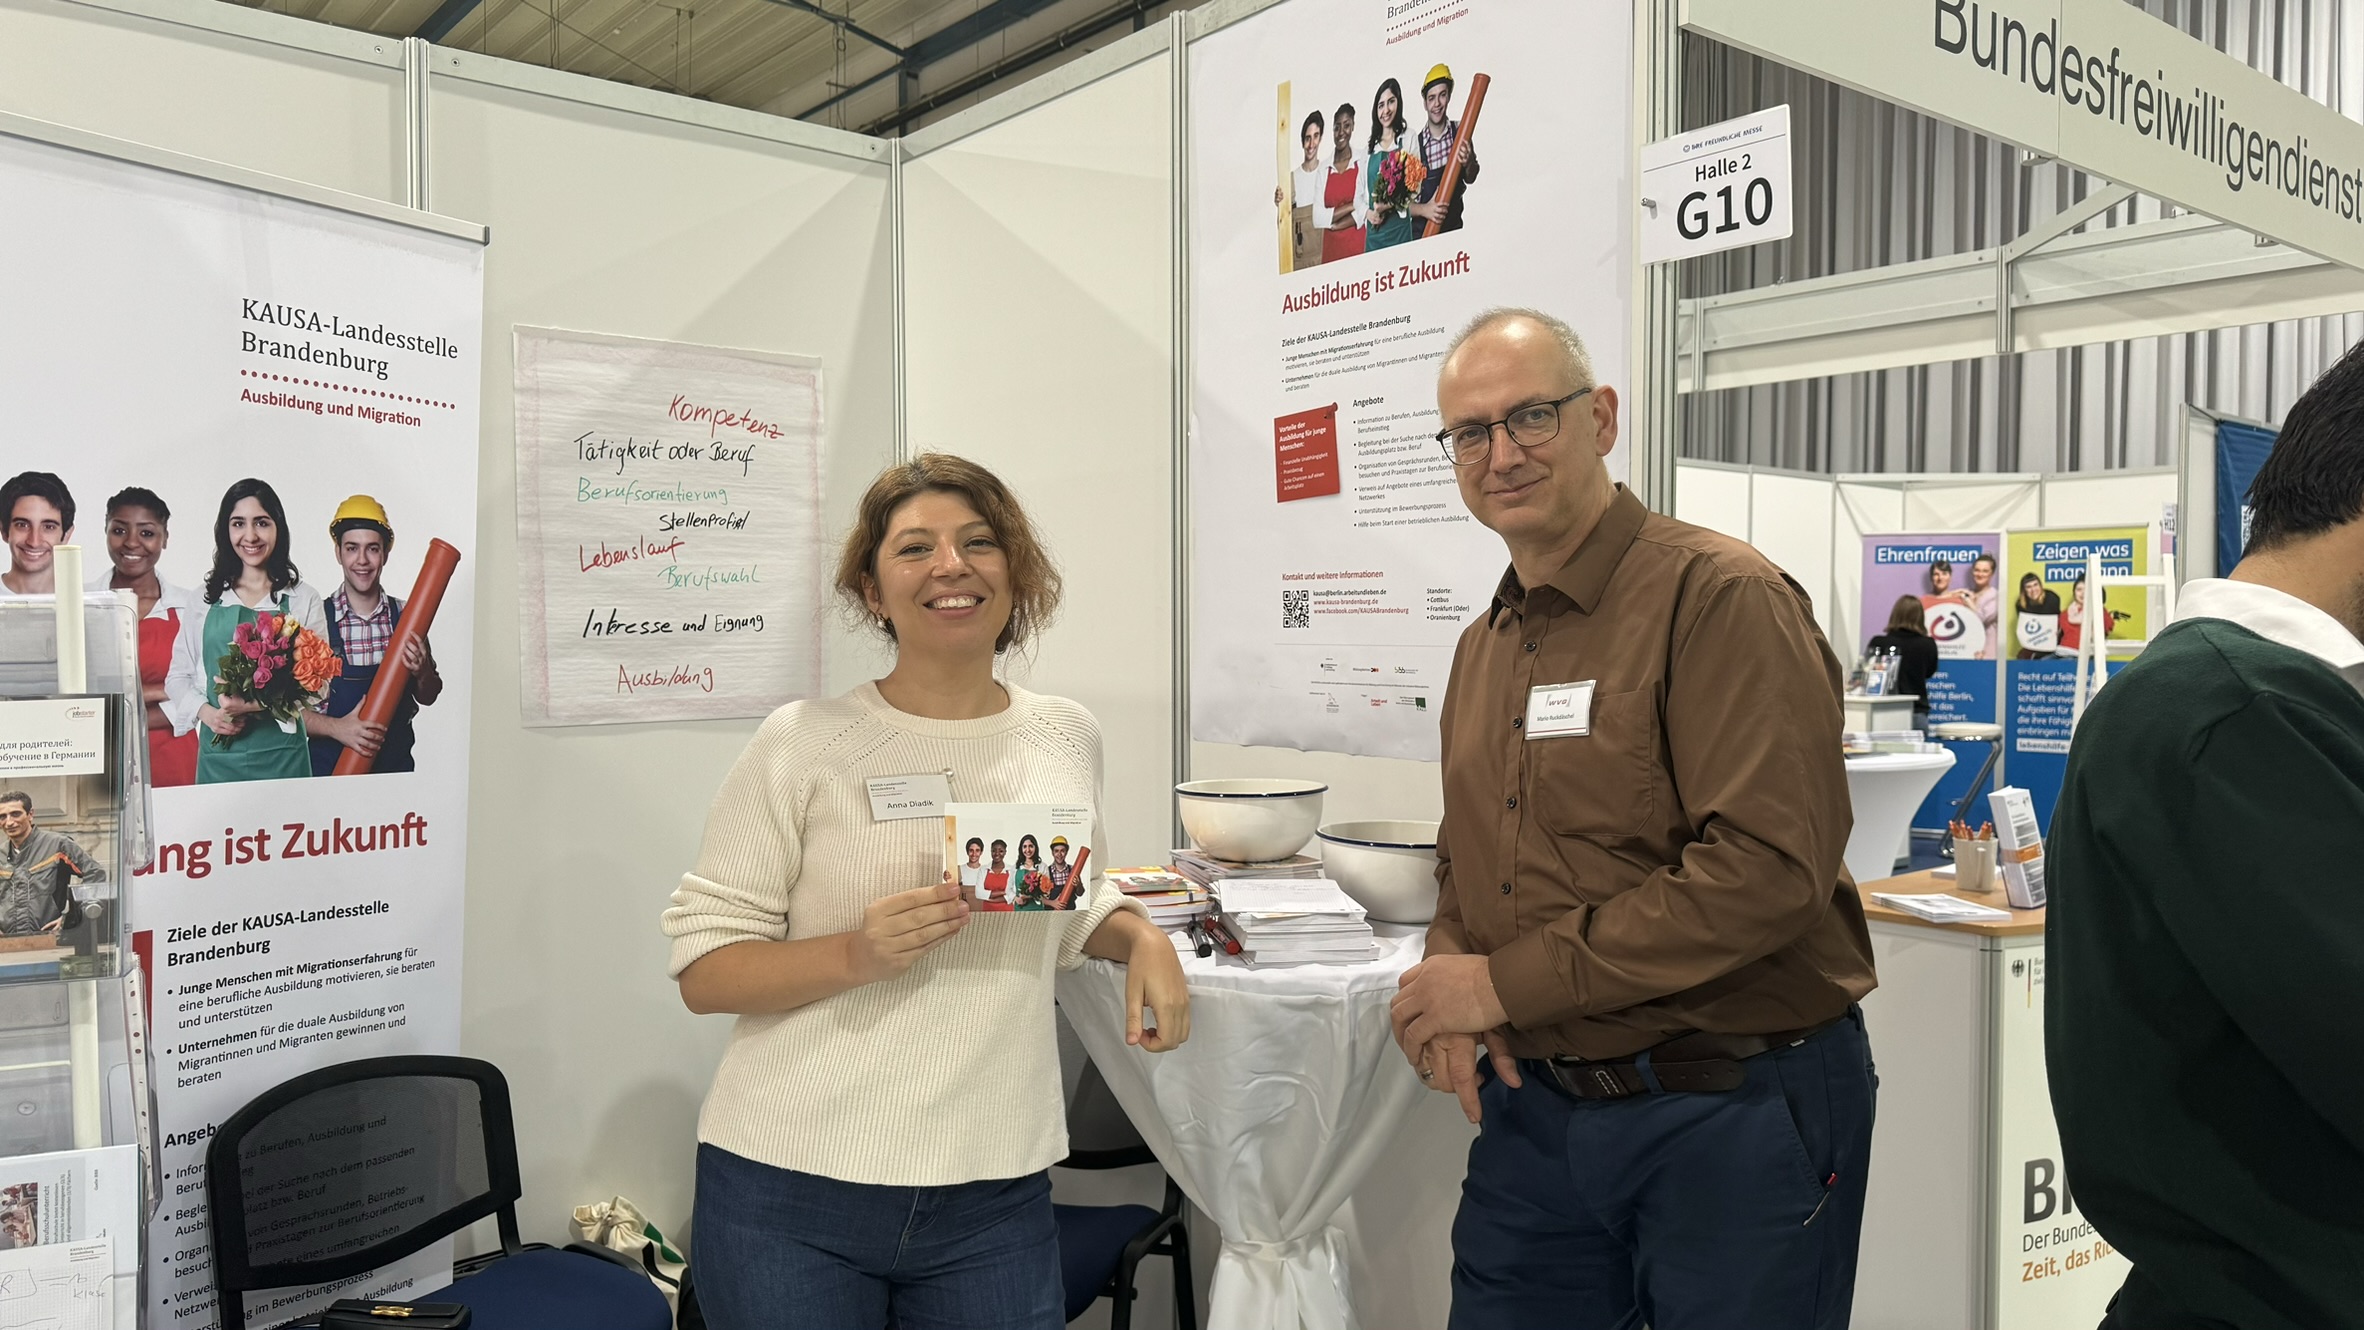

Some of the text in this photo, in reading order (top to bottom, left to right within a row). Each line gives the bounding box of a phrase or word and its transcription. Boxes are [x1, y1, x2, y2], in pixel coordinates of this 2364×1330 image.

[1386, 8, 1469, 46] Ausbildung und Migration
[1934, 0, 2363, 224] Bundesfreiwilligendienst
[1691, 125, 1763, 150] IHRE FREUNDLICHE MESSE
[1695, 153, 1752, 182] Halle 2
[1677, 177, 1773, 240] G10
[1282, 251, 1470, 314] Ausbildung ist Zukunft
[242, 298, 459, 360] KAUSA-Landesstelle
[1281, 315, 1411, 348] Ziele der KAUSA-Landesstelle Brandenburg
[1393, 332, 1417, 342] berufliche
[1417, 327, 1445, 337] Ausbildung
[241, 330, 390, 381] Brandenburg
[1418, 351, 1445, 361] Migranten
[241, 388, 422, 428] Ausbildung und Migration
[1353, 397, 1384, 408] Angebote
[668, 394, 785, 439] Kompetenz
[1357, 409, 1440, 425] Information Berufen, Ausbildung
[574, 431, 757, 477] Tätigkeit oder Beruf
[1358, 439, 1382, 448] Begleitung
[1358, 446, 1396, 456] Ausbildungsplatz
[1358, 461, 1387, 471] Organisation
[1358, 471, 1380, 479] besuchen
[1391, 467, 1418, 477] Praxistagen
[577, 477, 728, 506] Berufsorientierung
[1358, 493, 1385, 501] Netzwerkes
[1377, 483, 1385, 491] auf
[1386, 482, 1409, 491] Angebote
[1399, 503, 1446, 513] Bewerbungsprozess
[1408, 516, 1440, 525] betrieblichen
[1441, 515, 1470, 523] Ausbildung
[579, 535, 685, 573] Lebenslauf
[1877, 546, 1980, 564] Ehrenfrauen
[2035, 543, 2129, 562] Zeigen was
[657, 565, 761, 590] Berufswahl
[1282, 570, 1384, 581] Kontakt und weitere Informationen
[2100, 565, 2129, 576] ann
[682, 614, 707, 632] und
[714, 613, 764, 634] Eignung
[617, 664, 714, 694] Ausbildung
[2018, 672, 2056, 682] Recht auf
[2018, 683, 2031, 692] Die
[2057, 705, 2069, 714] für
[20, 738, 73, 750] родителей:
[51, 751, 96, 761] Германии
[224, 828, 271, 865] ist
[282, 811, 428, 860] Zukunft
[167, 900, 390, 943] Ziele der KAUSA-Landesstelle
[167, 937, 271, 967] Brandenburg
[179, 947, 418, 996] Junge Menschen mit Migrationserfahrung für
[179, 959, 436, 1013] eine berufliche Ausbildung motivieren, sie beraten
[178, 1002, 273, 1030] und unterstützen
[178, 1002, 405, 1055] Unternehmen für die duale Ausbildung von
[178, 1016, 406, 1073] Migrantinnen und Migranten gewinnen und
[177, 1070, 222, 1089] beraten
[307, 1115, 387, 1146] Ausbildung und
[365, 1146, 415, 1170] passenden
[2023, 1233, 2050, 1253] Der
[2022, 1249, 2091, 1283] Zeit, das
[255, 1270, 374, 1316] im Bewerbungsprozess
[363, 1277, 414, 1302] Ausbildung
